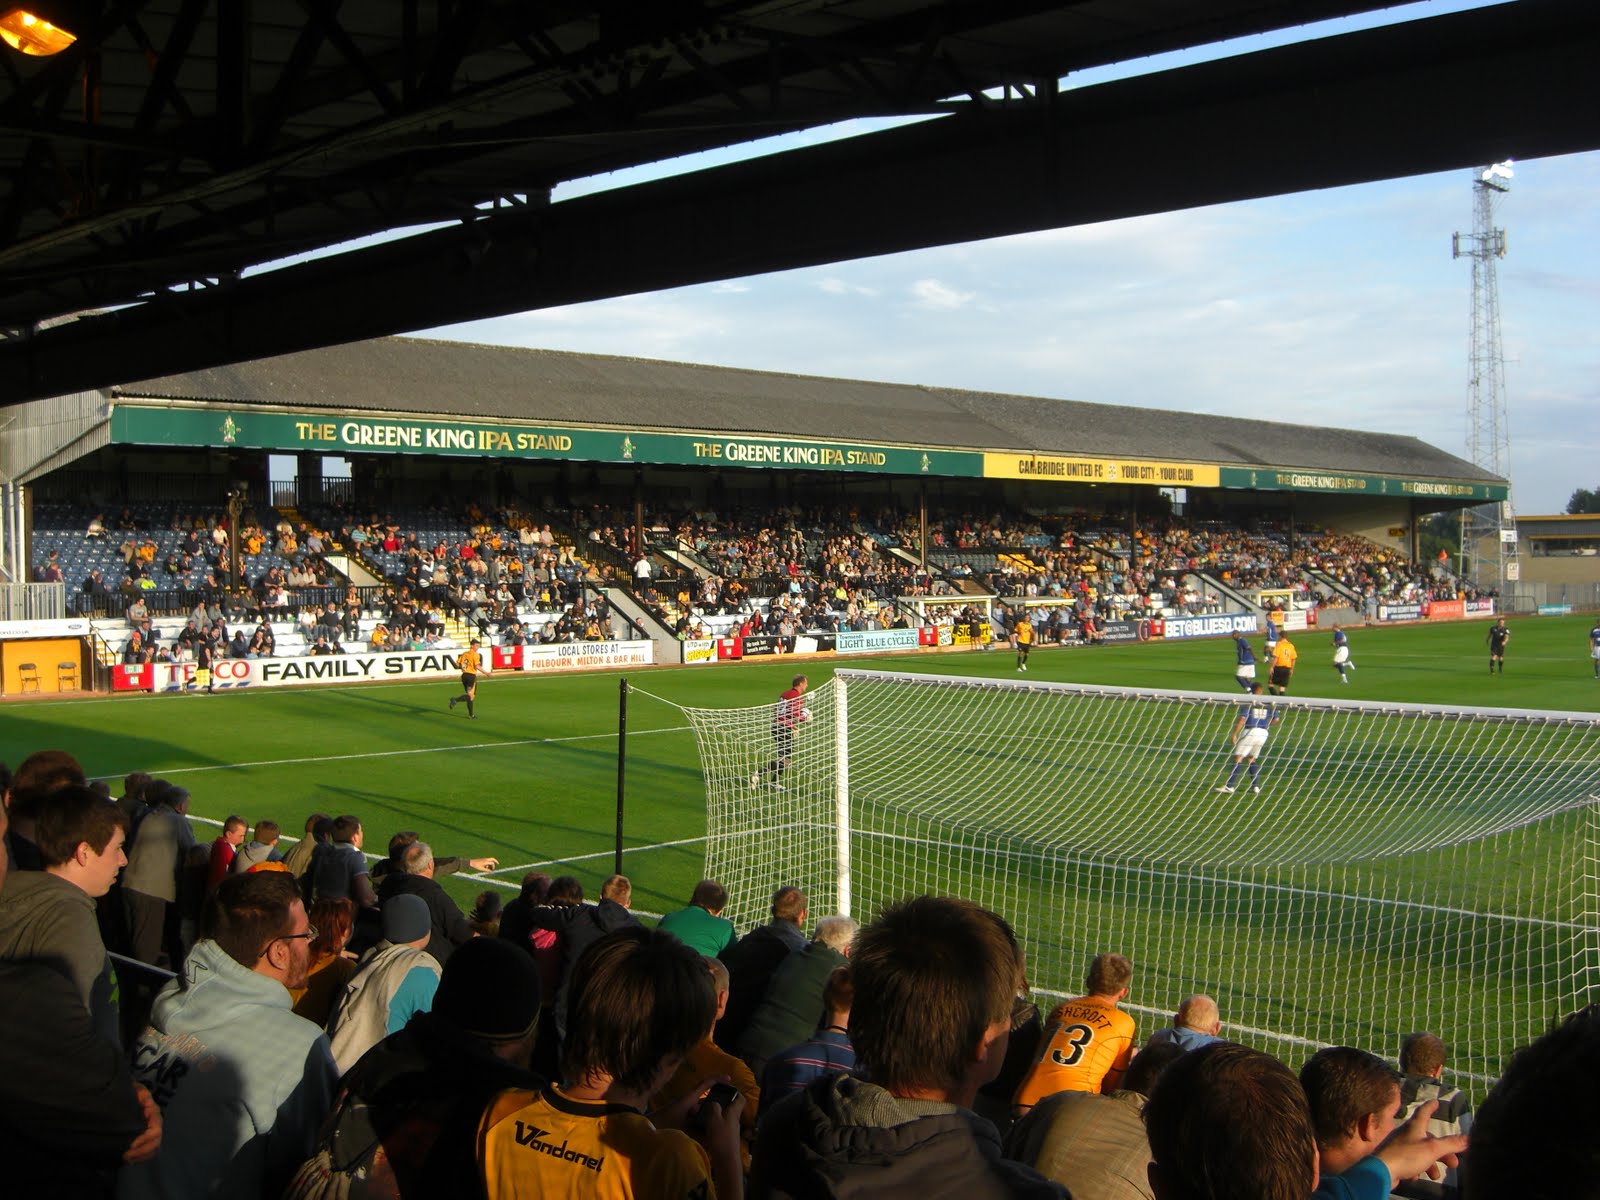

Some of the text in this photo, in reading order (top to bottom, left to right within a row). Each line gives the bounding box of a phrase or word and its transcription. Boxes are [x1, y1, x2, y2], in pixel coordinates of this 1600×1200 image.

[296, 422, 572, 452] THE GREENE KING IPA STAND
[694, 442, 886, 466] THE GREENE KING IPA STAND
[1066, 462, 1093, 477] UNITED
[1094, 464, 1103, 477] FC
[1121, 464, 1140, 479] YOUR
[1140, 466, 1156, 480] CITY
[1160, 467, 1177, 481] YOUR
[1178, 468, 1194, 481] CLUB
[1277, 474, 1291, 485] THE
[1291, 474, 1318, 487] GREENE
[1318, 476, 1335, 489] KING
[1413, 482, 1435, 494] GREENE
[1434, 484, 1448, 495] KING
[1165, 613, 1257, 638] BET@BLUESQ.COM
[558, 643, 619, 656] LOCAL STORES AT
[839, 635, 915, 649] LIGHT BLUE CYCLES
[262, 658, 376, 681] FAMILY
[385, 654, 483, 675] STAN
[531, 654, 646, 669] FULBOURN, MILTON & BAR HILL
[164, 660, 251, 682] TECO
[514, 1119, 605, 1172] Vandanel
